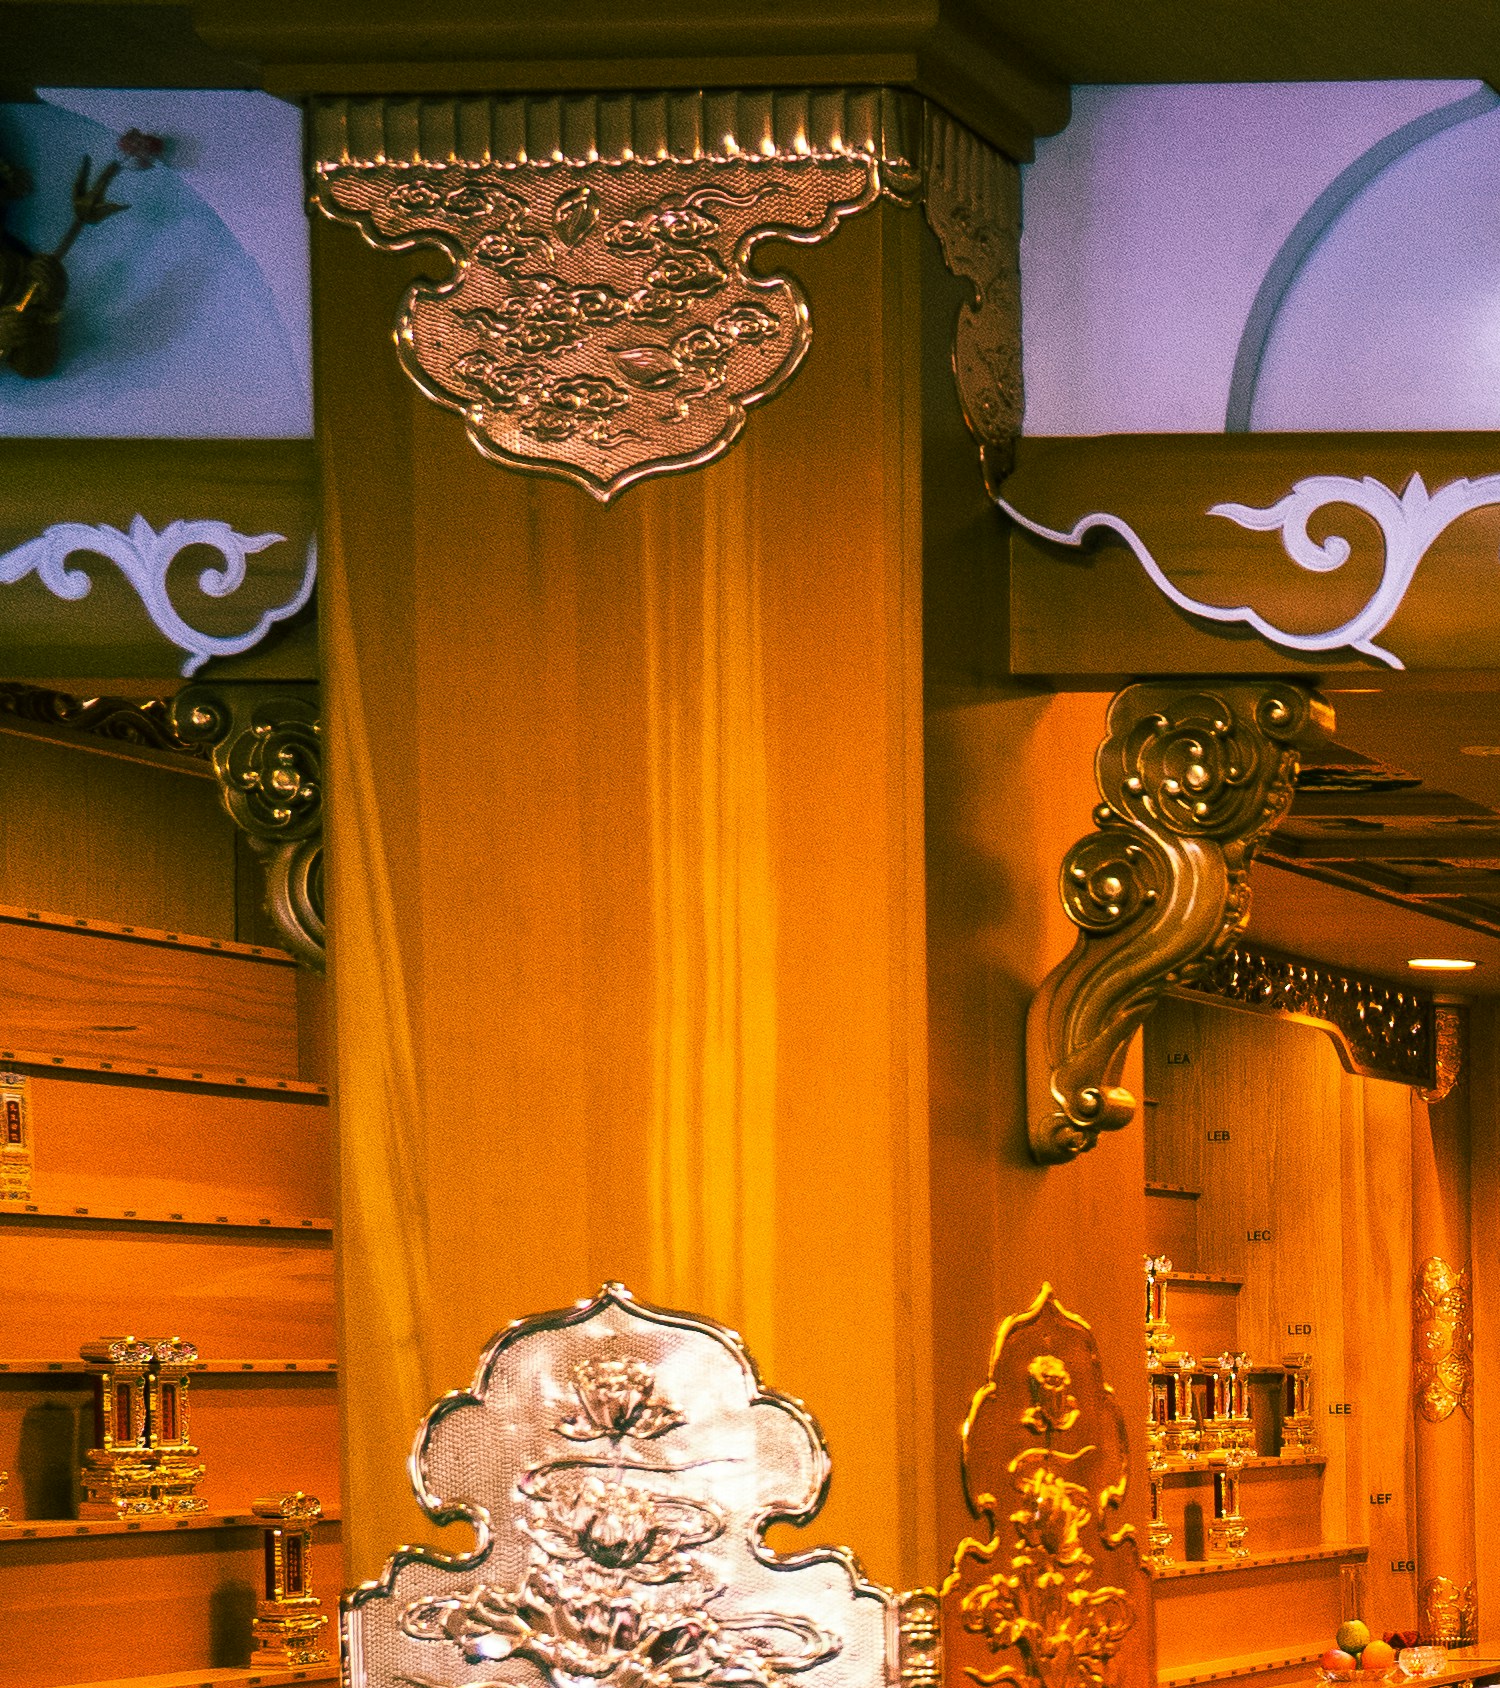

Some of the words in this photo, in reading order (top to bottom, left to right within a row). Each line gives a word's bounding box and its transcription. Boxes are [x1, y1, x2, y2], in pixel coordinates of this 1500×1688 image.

[1167, 1054, 1190, 1064] LEA
[1208, 1131, 1230, 1141] LEB
[1247, 1231, 1270, 1241] LEC
[1288, 1325, 1311, 1335] LED
[1329, 1404, 1351, 1414] LEE
[1370, 1494, 1391, 1505] LEF
[1392, 1560, 1415, 1572] LEG
